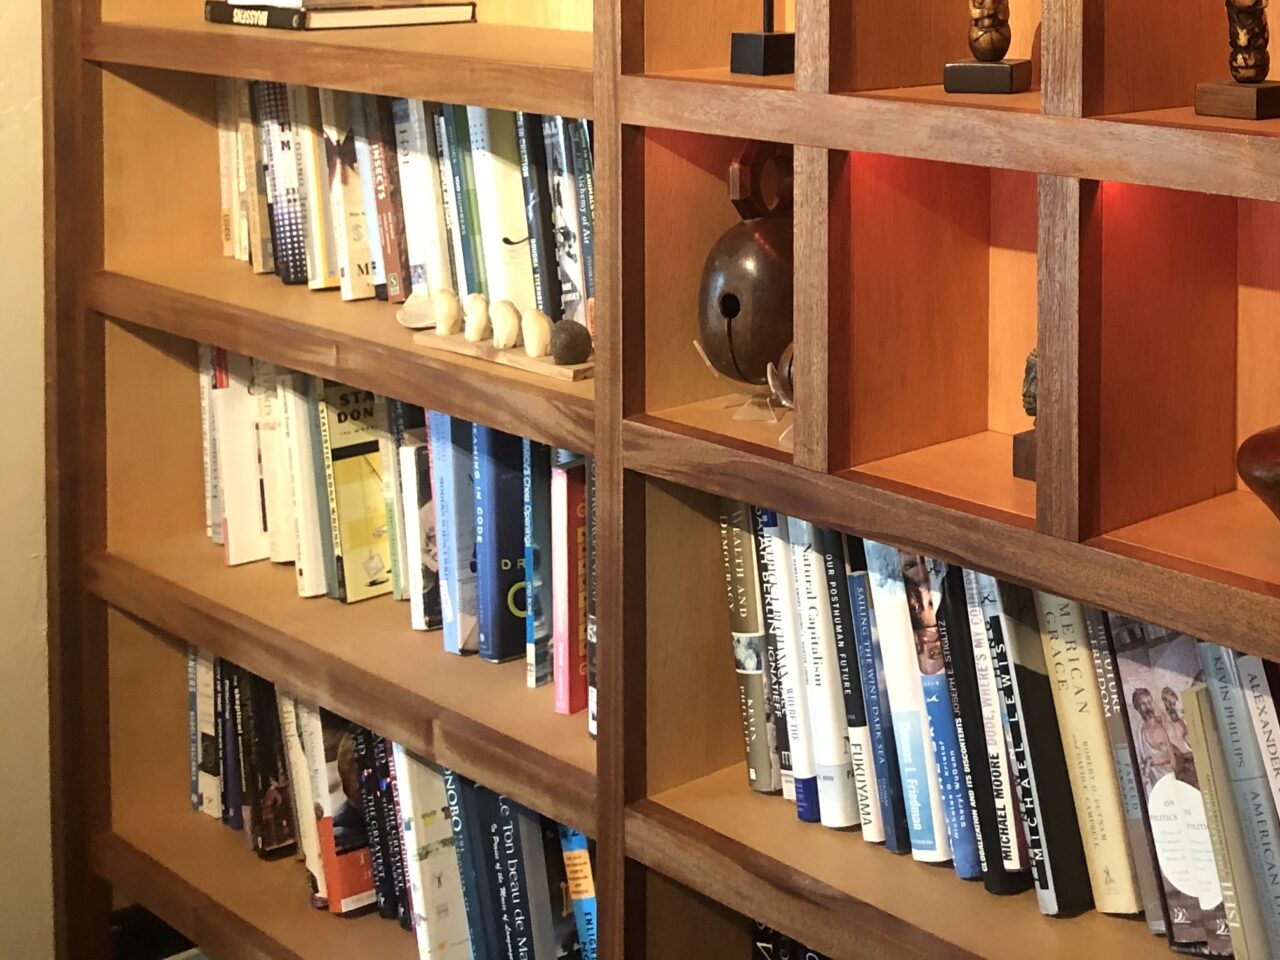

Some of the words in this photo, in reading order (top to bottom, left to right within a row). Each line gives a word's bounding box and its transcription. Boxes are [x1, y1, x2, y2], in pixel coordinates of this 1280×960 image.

[233, 8, 269, 27] BRASSENS
[371, 143, 385, 200] INSECTS
[582, 216, 588, 226] of
[583, 229, 591, 244] Air
[336, 406, 375, 424] DON
[339, 391, 375, 407] STA
[320, 409, 330, 470] STATISTICS
[326, 473, 335, 504] DONE
[476, 486, 481, 500] IN
[524, 505, 532, 548] Openings
[825, 553, 837, 576] OUR
[736, 587, 748, 618] AND
[829, 581, 846, 648] POSTHUMAN
[807, 605, 824, 688] Capitalism
[937, 619, 954, 663] STIGLITZ
[972, 630, 985, 648] MY
[1043, 611, 1069, 692] GRACE
[767, 645, 782, 719] IGNATIEFF
[839, 653, 852, 695] FUTURE
[854, 586, 869, 637] SAILING
[863, 639, 874, 665] THE
[877, 744, 886, 765] SEA
[946, 677, 961, 715] JOSEPH
[975, 653, 994, 708] WHERE'S
[996, 641, 1019, 721] LEWIS
[1089, 639, 1112, 718] FREEDOM
[234, 688, 243, 734] skeptical
[1212, 655, 1232, 702] KEVIN
[1223, 706, 1246, 769] PHILLIPS
[955, 717, 971, 773] DISCONTENTS
[850, 742, 874, 827] FUKUYAMA
[898, 721, 914, 764] Thomas
[906, 779, 924, 832] Friedman
[965, 775, 974, 788] ITS
[967, 790, 977, 807] AND
[989, 751, 1005, 800] MOORE
[1015, 742, 1045, 861] MICHAEL
[371, 821, 385, 879] GREATEST
[502, 821, 514, 855] Ton
[971, 809, 988, 871] GLOBALIZATION
[996, 804, 1014, 861] MICHAEL
[1249, 789, 1280, 886] AMERICAN
[392, 831, 404, 888] GREATEST
[507, 859, 523, 903] beau
[515, 909, 526, 931] de
